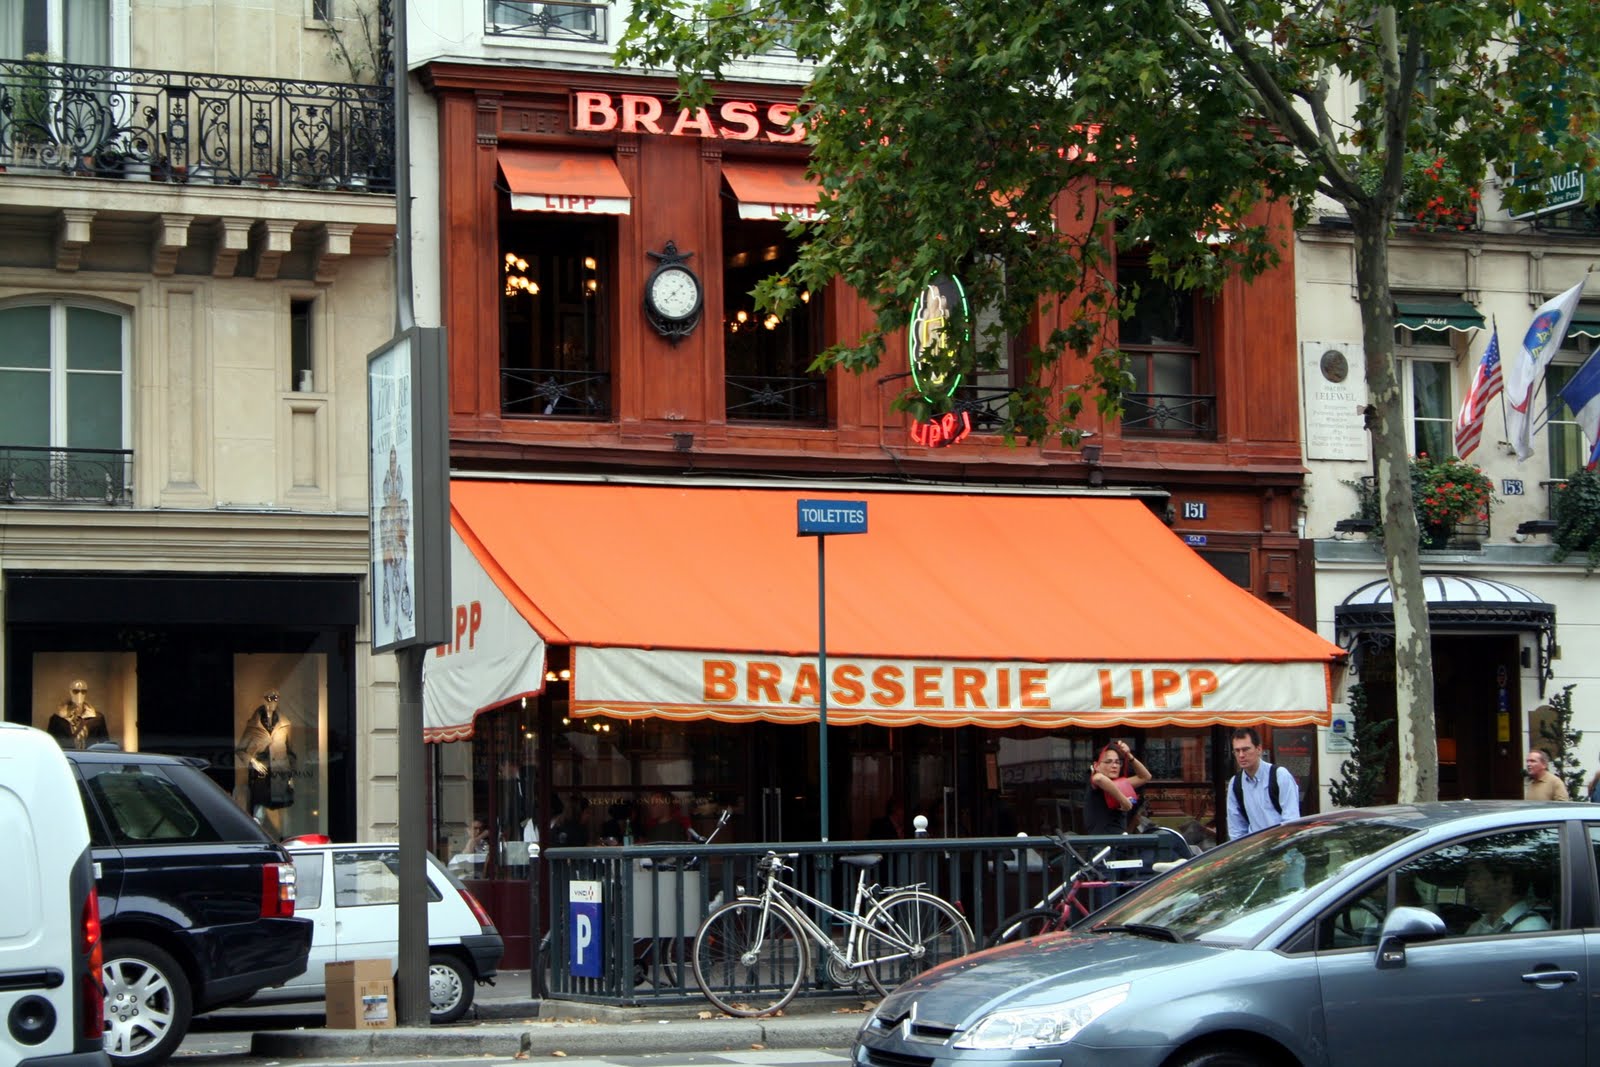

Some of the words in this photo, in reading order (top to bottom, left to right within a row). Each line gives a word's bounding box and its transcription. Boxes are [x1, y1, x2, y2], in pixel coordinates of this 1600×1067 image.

[576, 92, 880, 144] BRASS
[545, 194, 596, 210] LIPP
[1504, 480, 1523, 495] 153
[801, 508, 865, 524] TOILETTES
[1184, 502, 1205, 519] 151
[436, 600, 482, 658] PP
[702, 659, 1052, 710] BRASSERIE
[1098, 668, 1220, 709] LIPP
[576, 913, 592, 965] P
